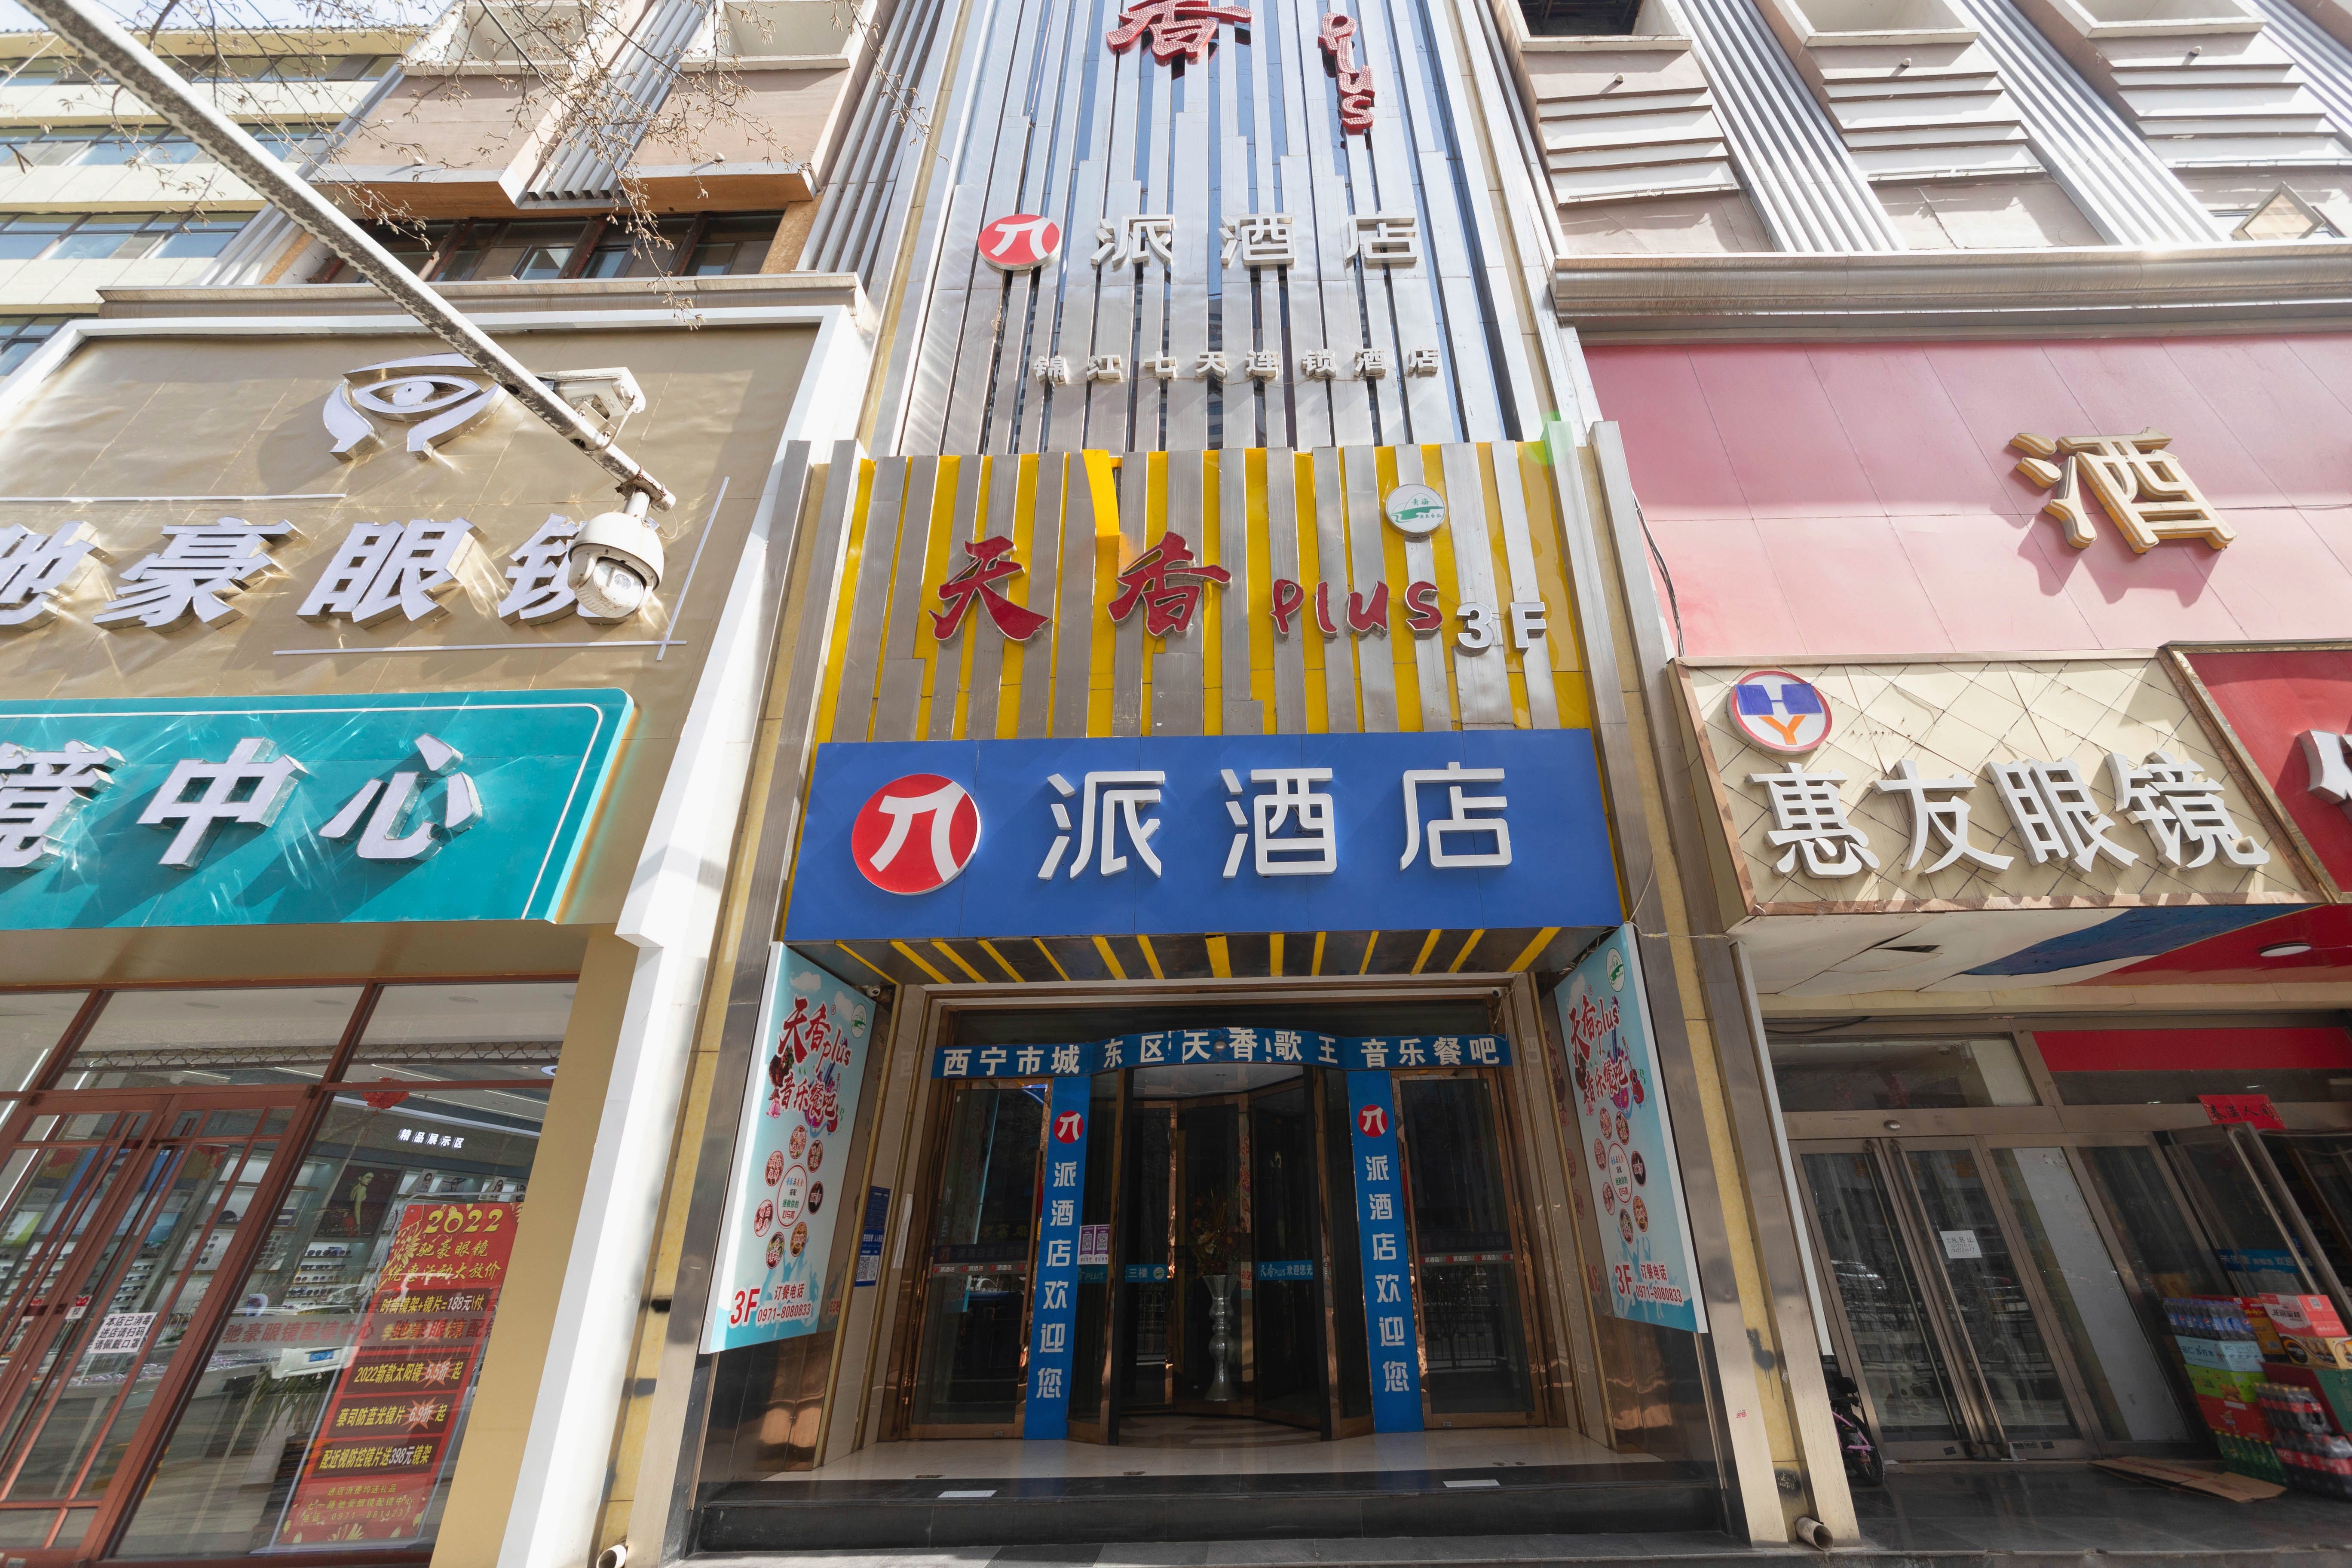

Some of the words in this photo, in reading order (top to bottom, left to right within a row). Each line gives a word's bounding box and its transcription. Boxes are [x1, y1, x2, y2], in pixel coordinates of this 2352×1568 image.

[1090, 214, 1418, 266] 派酒店
[1034, 347, 1439, 384] 锦江七天连锁酒店
[2009, 427, 2237, 554] 酒
[929, 532, 1232, 643] 天香
[1456, 602, 1547, 654] 3F
[1037, 761, 1511, 879] 派酒店
[1746, 750, 2271, 880] 惠友眼镜
[1586, 1059, 1628, 1103] 音乐餐吧
[780, 1071, 837, 1117] 音乐餐吧
[398, 1129, 464, 1148] 精品展示区
[423, 1209, 503, 1234] 2022
[416, 1239, 489, 1259] 驰豪眼镜
[388, 1261, 501, 1282] 优惠活动大放价
[1036, 1162, 1077, 1398] 派酒店欢迎您
[1366, 1155, 1409, 1392] 派酒店欢迎您
[1615, 1265, 1632, 1295] 3F
[1640, 1263, 1667, 1281] 订餐电话
[774, 1284, 805, 1300] 订餐电话
[1635, 1284, 1682, 1303] 0971-8080833
[731, 1289, 760, 1324] 3F
[757, 1303, 811, 1322] 0971-8080833
[99, 1326, 145, 1338] 进店请扫码
[105, 1314, 153, 1327] 本店已消毒
[94, 1338, 139, 1350] 请佩戴口罩
[354, 1362, 424, 1383] 2022新款太阳镜
[425, 1361, 450, 1380] 5.5折
[451, 1361, 463, 1380] 起
[336, 1406, 405, 1427] 蔡司防蓝光镜片
[409, 1405, 434, 1422] 6.9折
[435, 1404, 447, 1422] 起
[319, 1445, 432, 1470] 配近视防控镜片送398元镜架
[327, 1484, 396, 1496] 进店消费均送礼品
